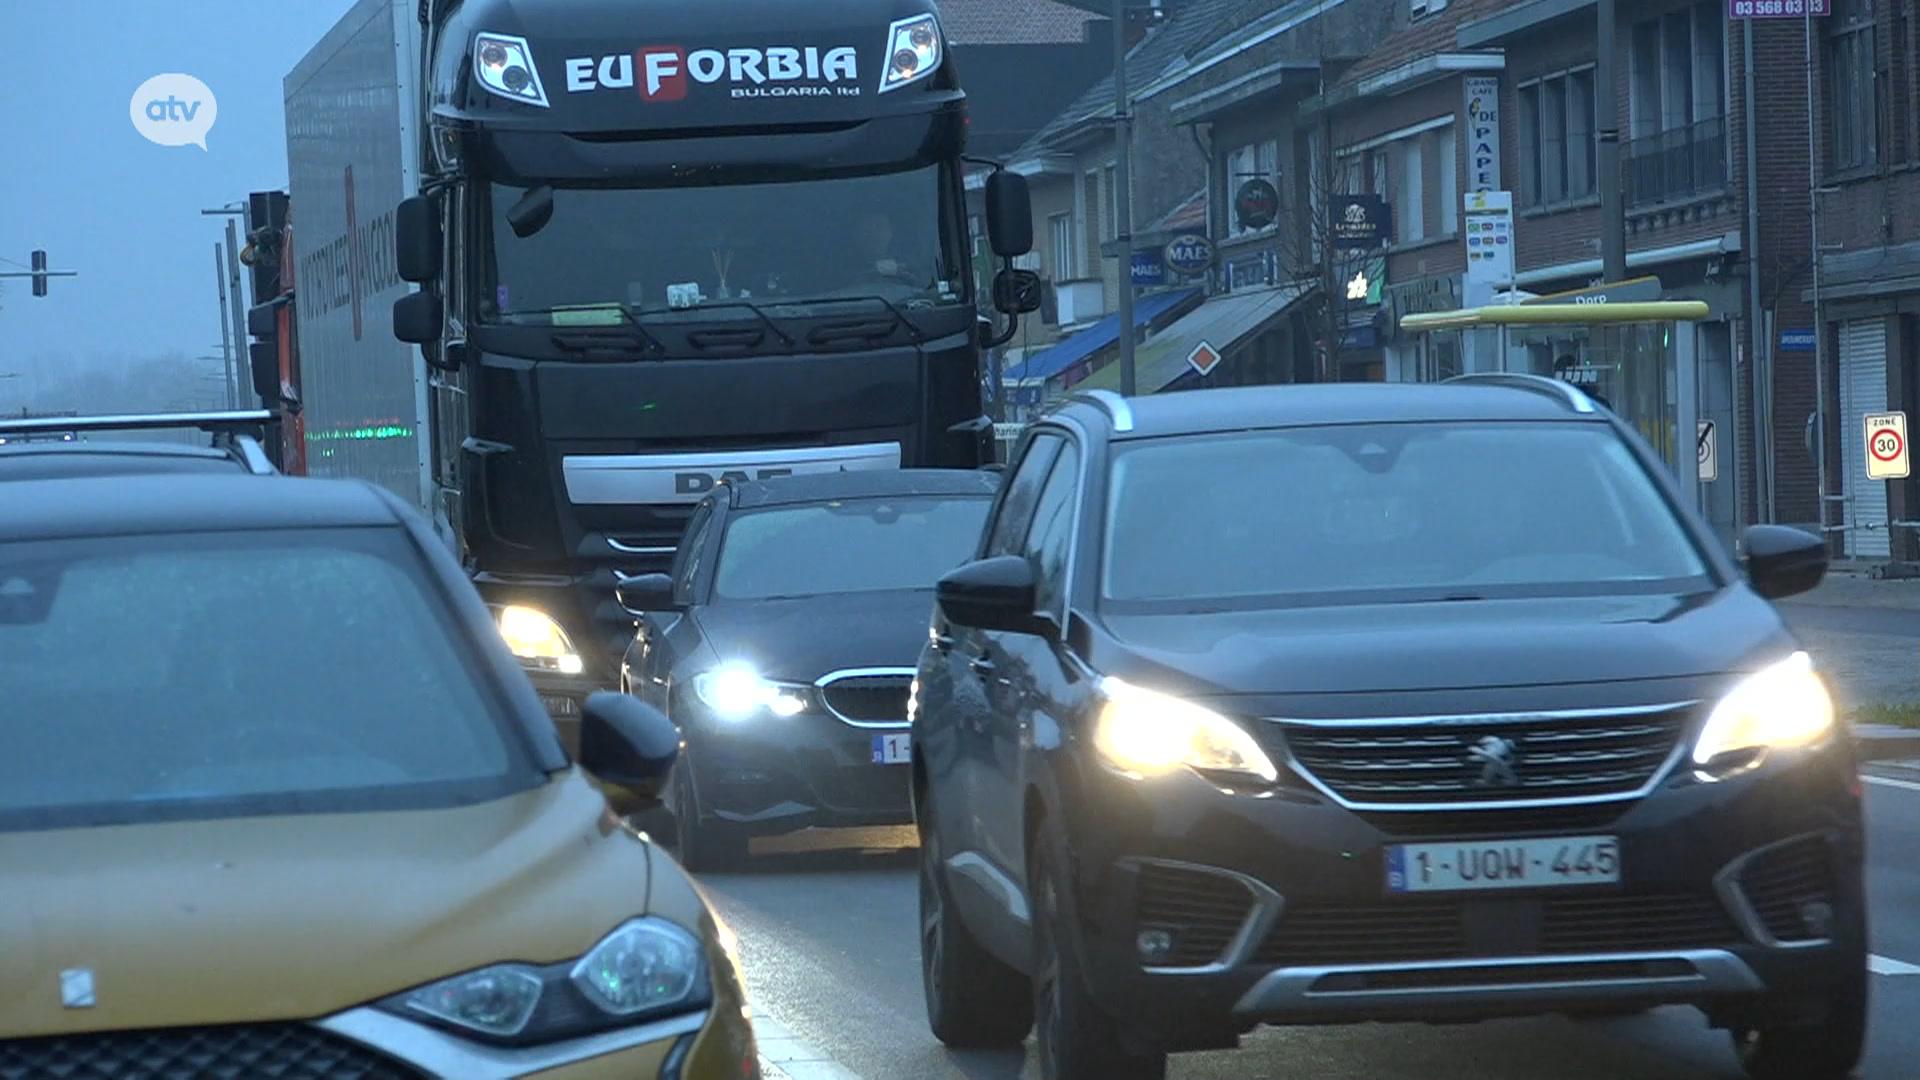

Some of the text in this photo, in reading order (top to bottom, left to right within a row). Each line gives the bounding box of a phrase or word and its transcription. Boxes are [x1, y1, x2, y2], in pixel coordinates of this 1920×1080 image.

[1735, 1, 1753, 15] 03
[1756, 1, 1782, 14] 568
[1785, 0, 1803, 14] 03
[566, 47, 857, 96] EUFORBIA
[731, 88, 831, 98] BULGARIA
[1480, 111, 1497, 122] DE
[1169, 246, 1209, 261] MAES
[1873, 417, 1896, 427] ZONE
[1877, 438, 1896, 453] 30
